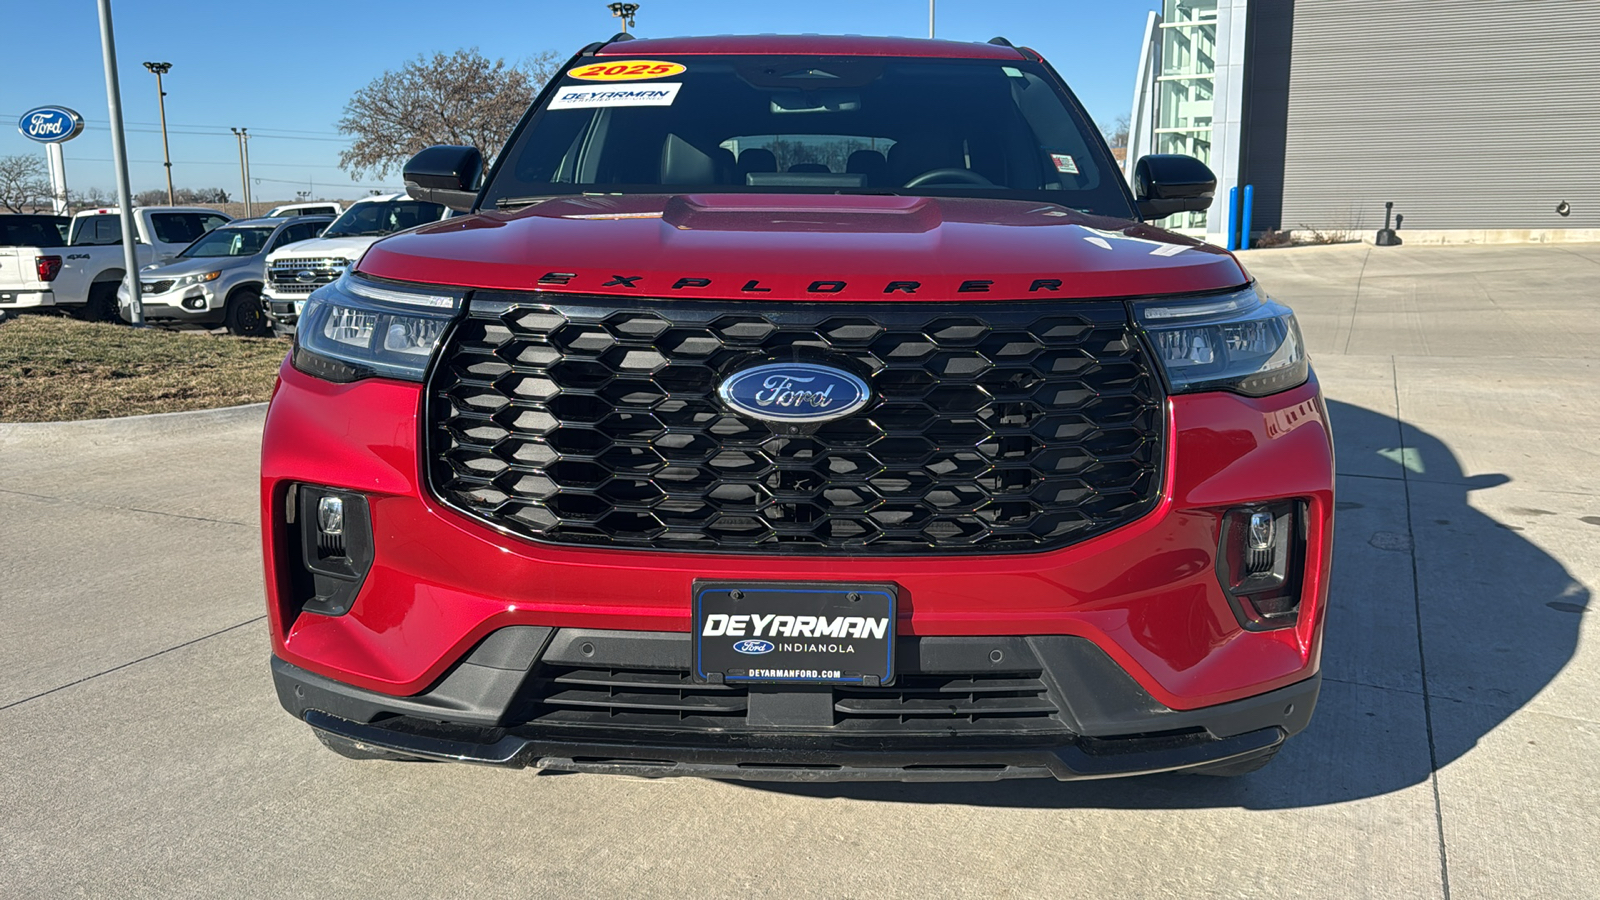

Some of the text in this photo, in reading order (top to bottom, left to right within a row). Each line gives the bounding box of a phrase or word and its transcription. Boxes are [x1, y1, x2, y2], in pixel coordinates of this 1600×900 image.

[579, 65, 674, 76] 2025
[561, 91, 670, 100] DEYARMAN
[29, 113, 63, 135] Ford
[537, 272, 1063, 294] EXPLORER
[755, 374, 835, 408] Ford
[702, 614, 889, 639] DEYARMAN
[741, 641, 855, 654] Ford INDIANOLA
[749, 669, 841, 678] DEYARMANFORD.COM
